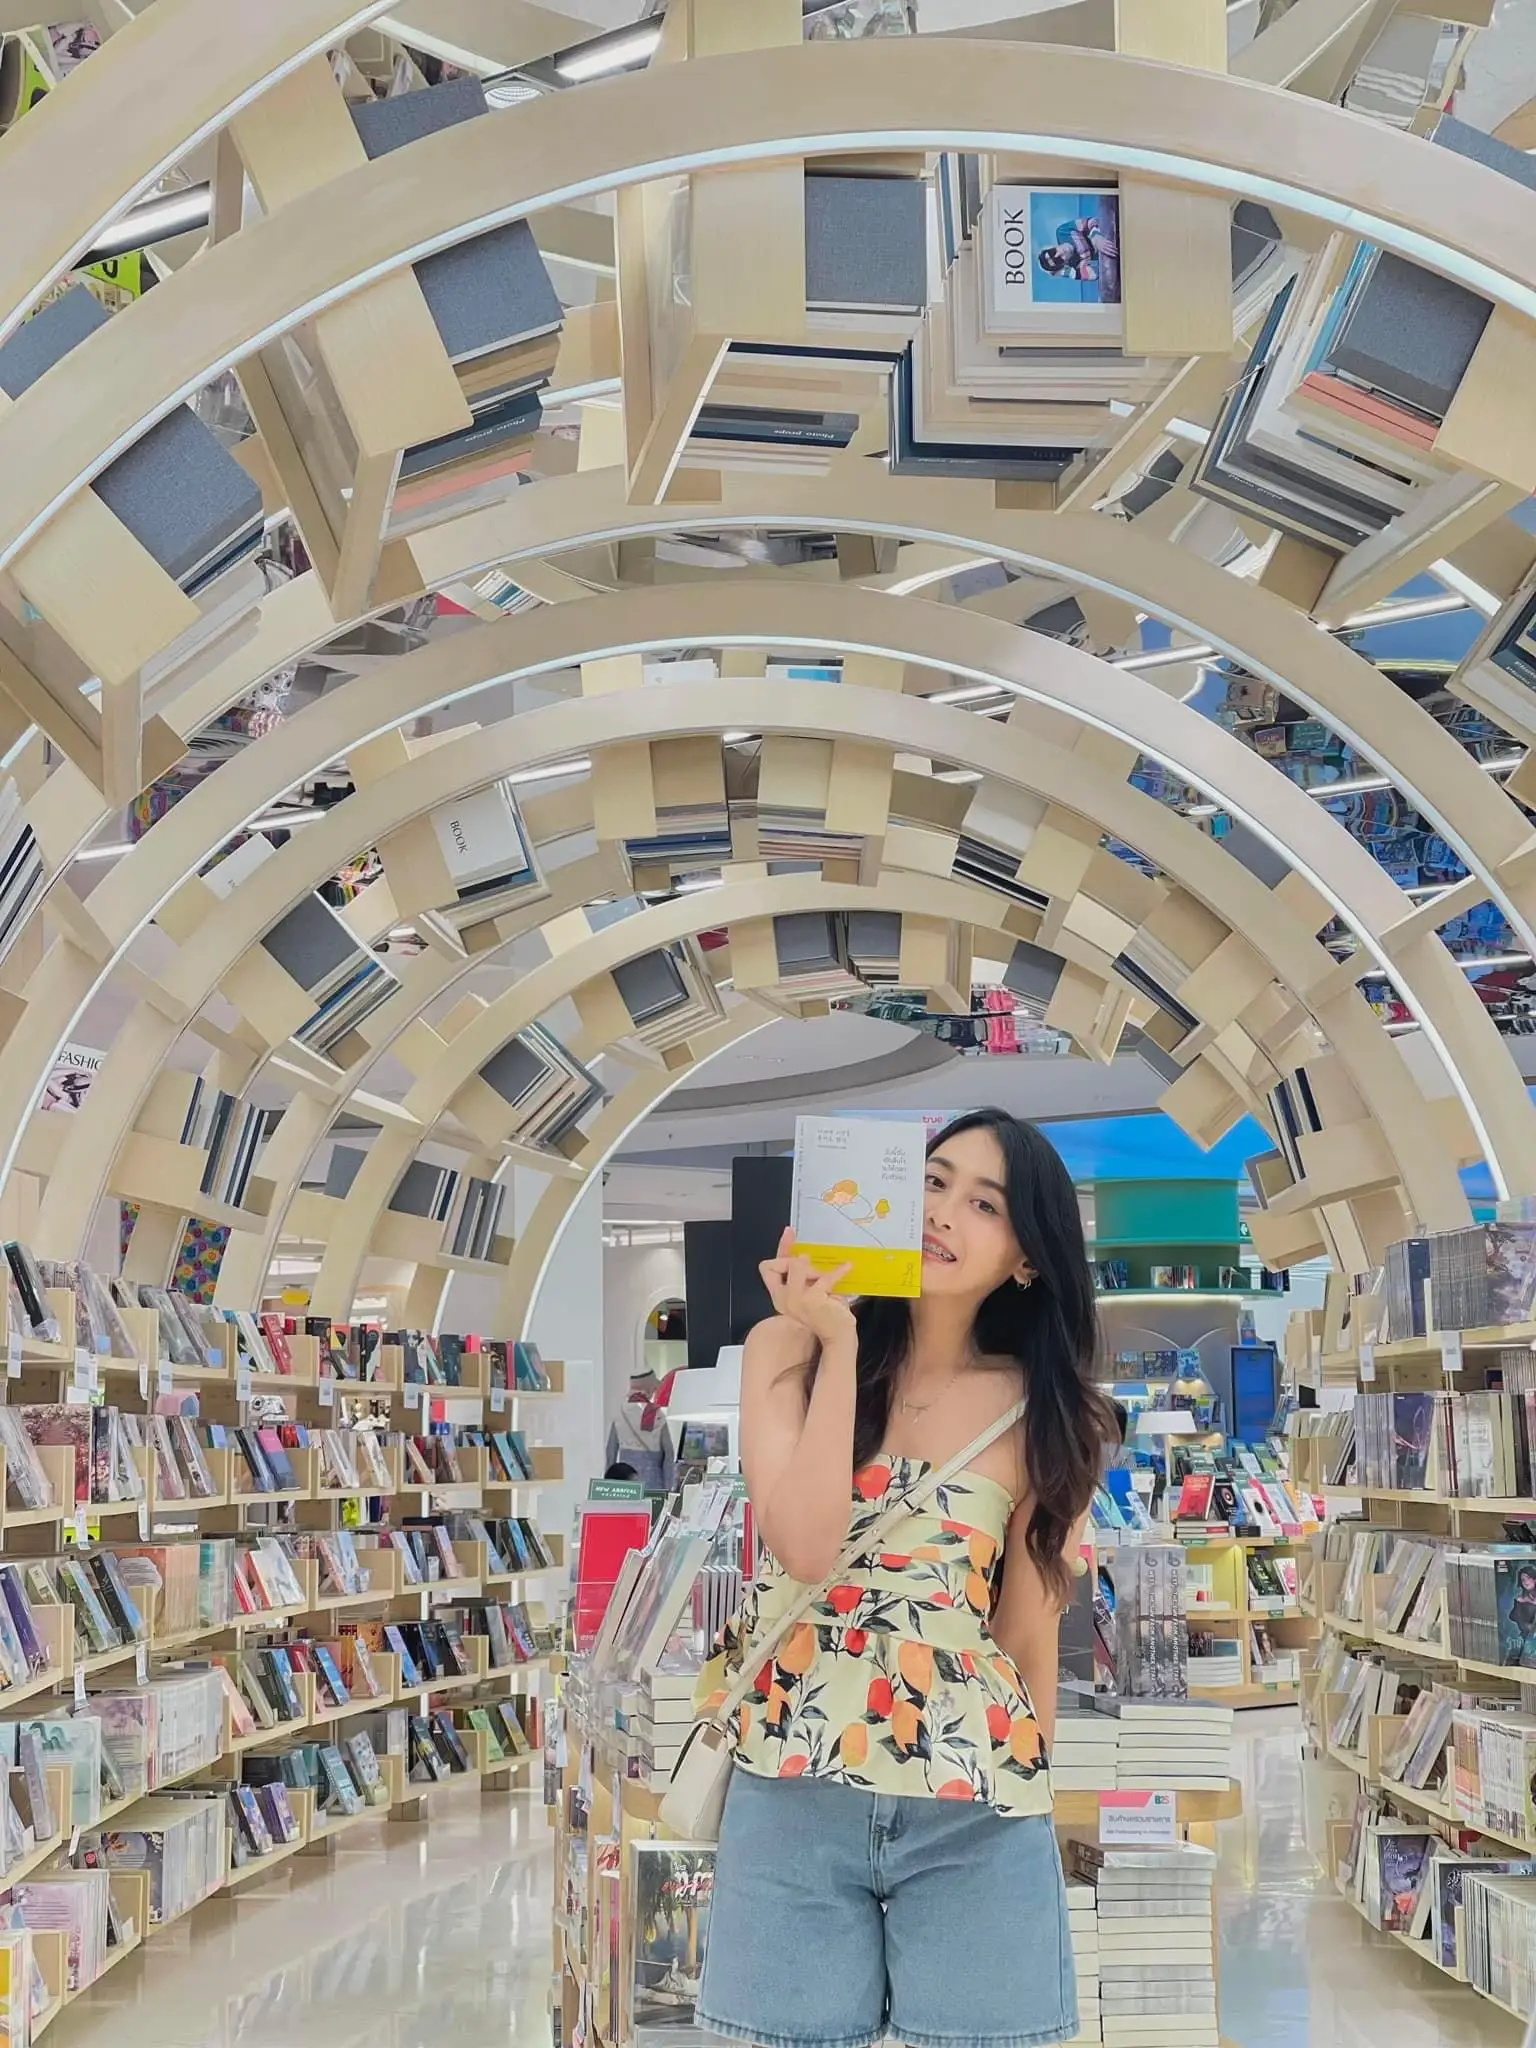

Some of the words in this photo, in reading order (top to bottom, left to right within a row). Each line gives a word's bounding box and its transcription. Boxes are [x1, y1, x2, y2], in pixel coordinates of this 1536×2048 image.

[1003, 208, 1026, 286] BOOK
[450, 820, 468, 854] BOOK
[1154, 1795, 1170, 1805] B2S
